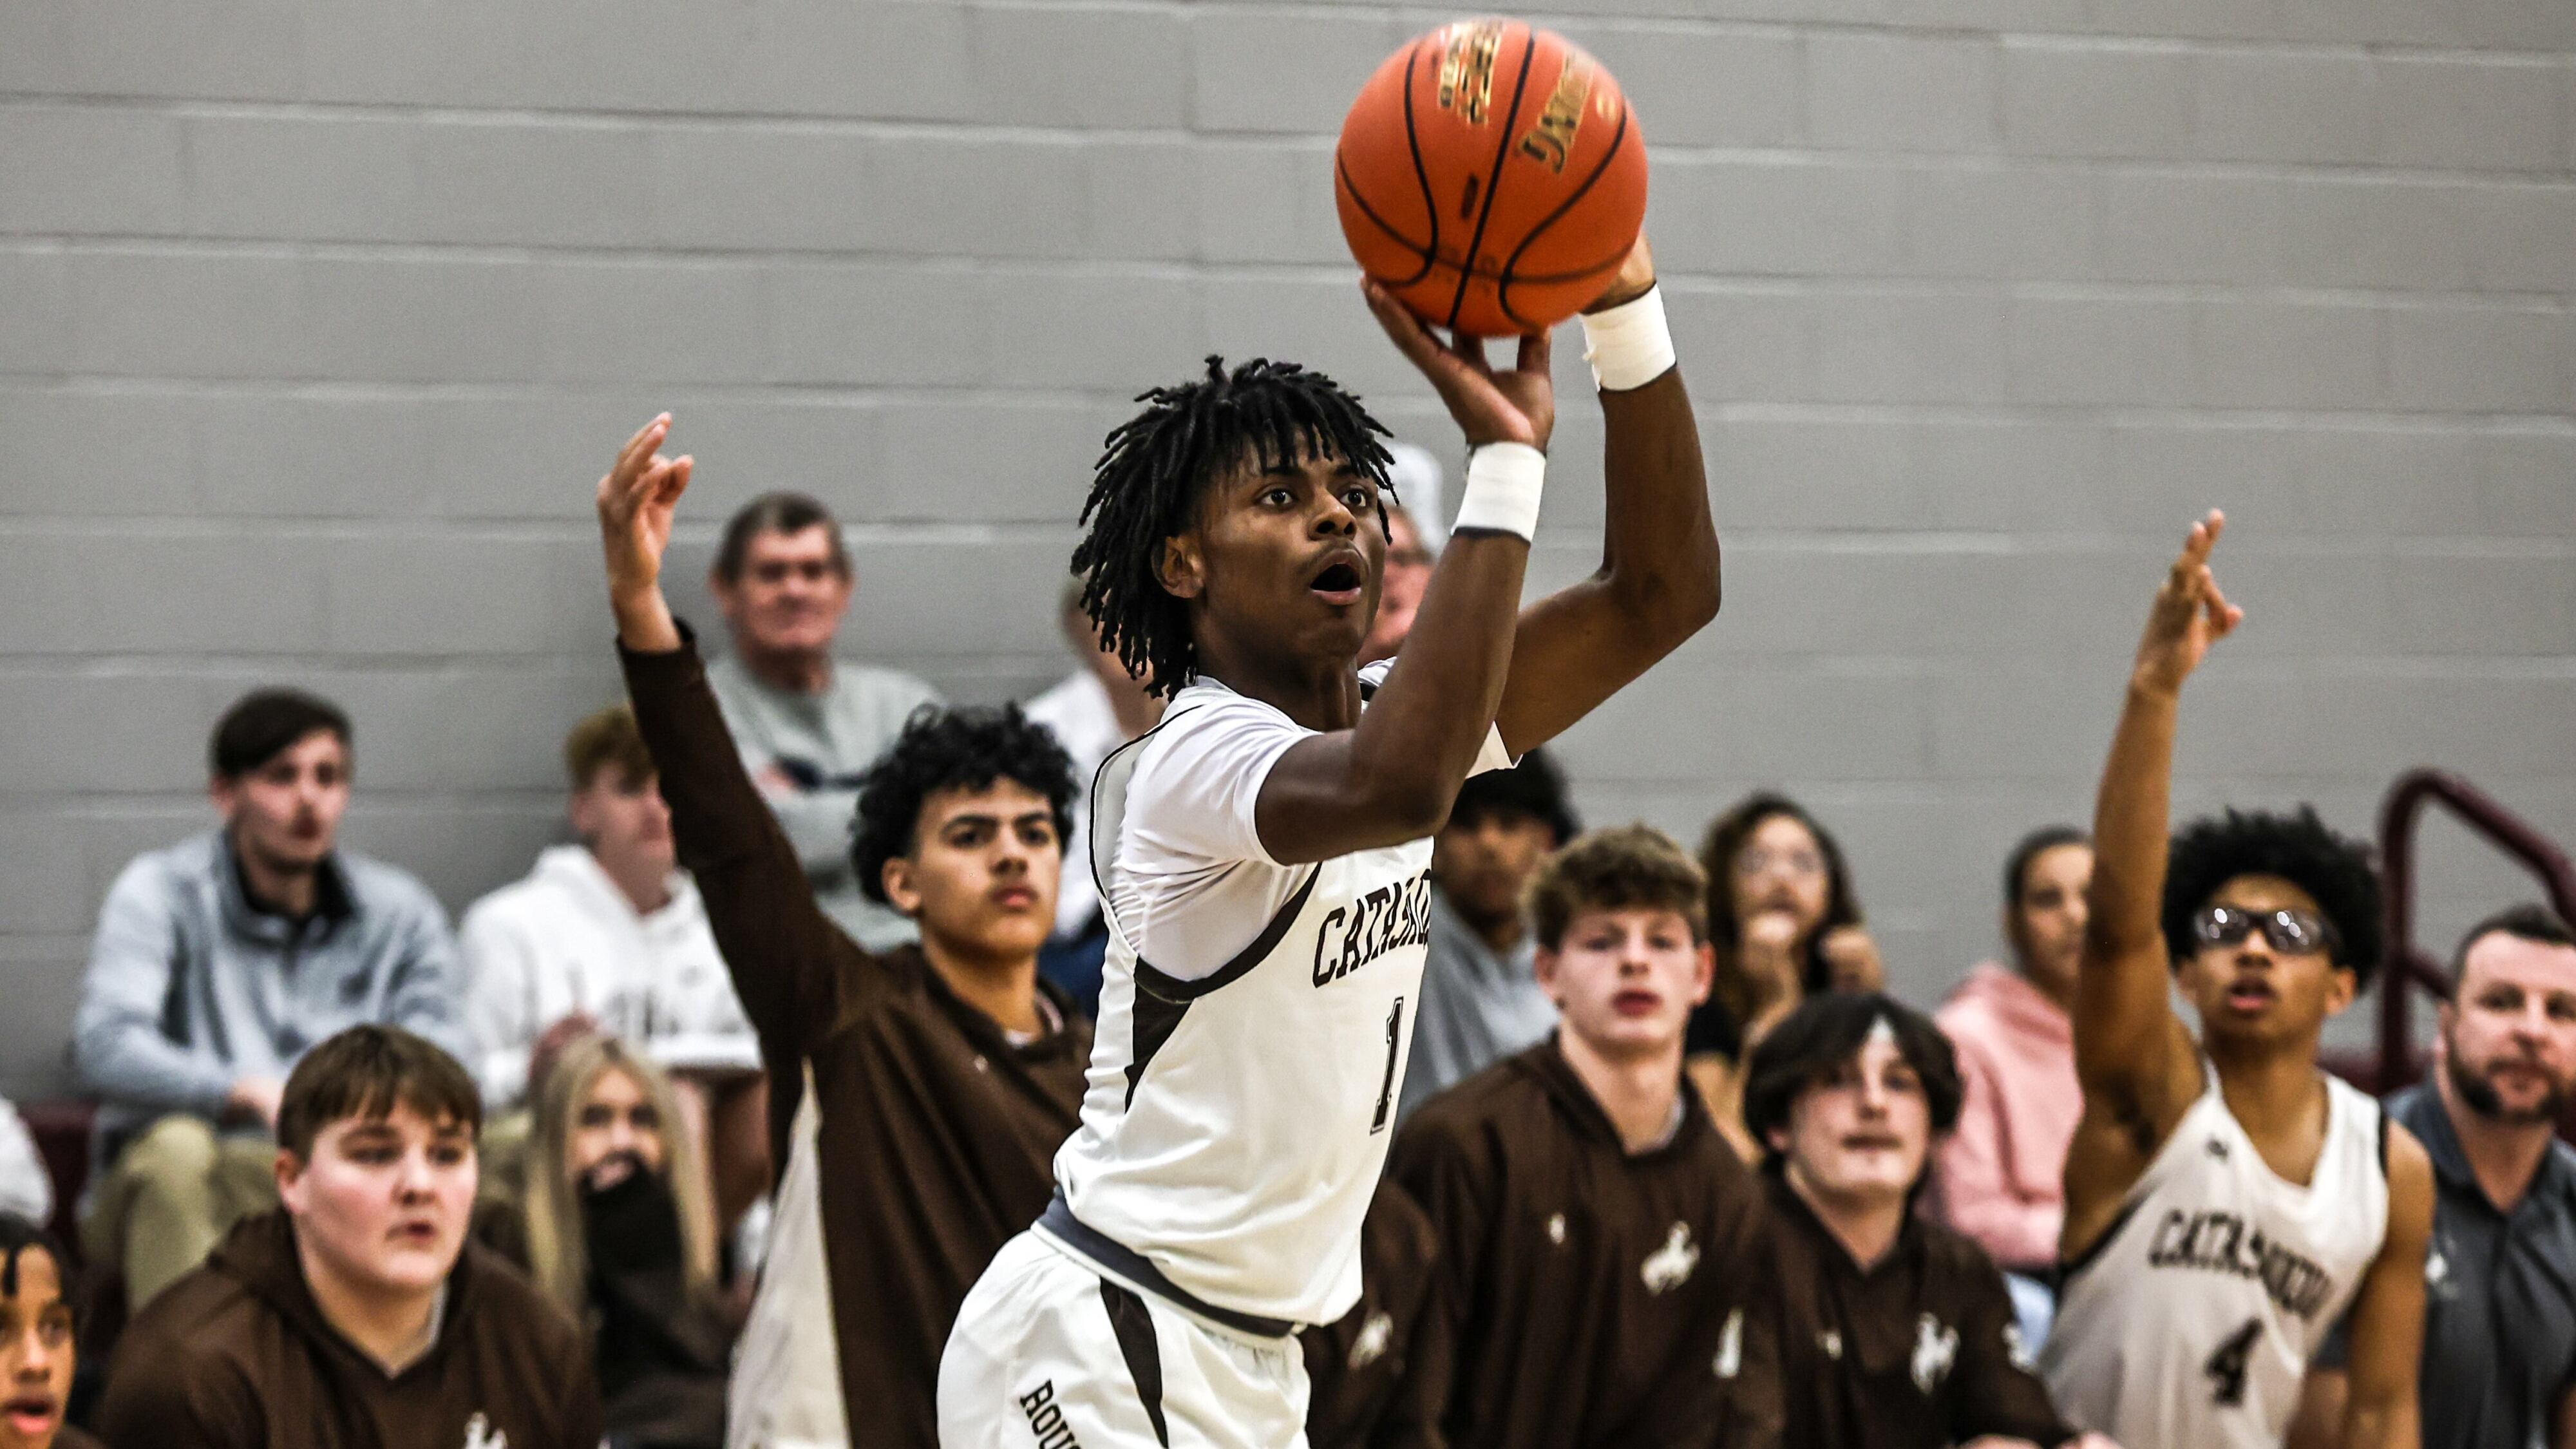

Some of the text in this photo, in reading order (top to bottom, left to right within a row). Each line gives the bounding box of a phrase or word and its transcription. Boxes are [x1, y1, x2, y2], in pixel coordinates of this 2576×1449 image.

[1370, 996, 1403, 1136] 1
[2205, 1318, 2262, 1406] 4
[1019, 1378, 1081, 1449] ROU
